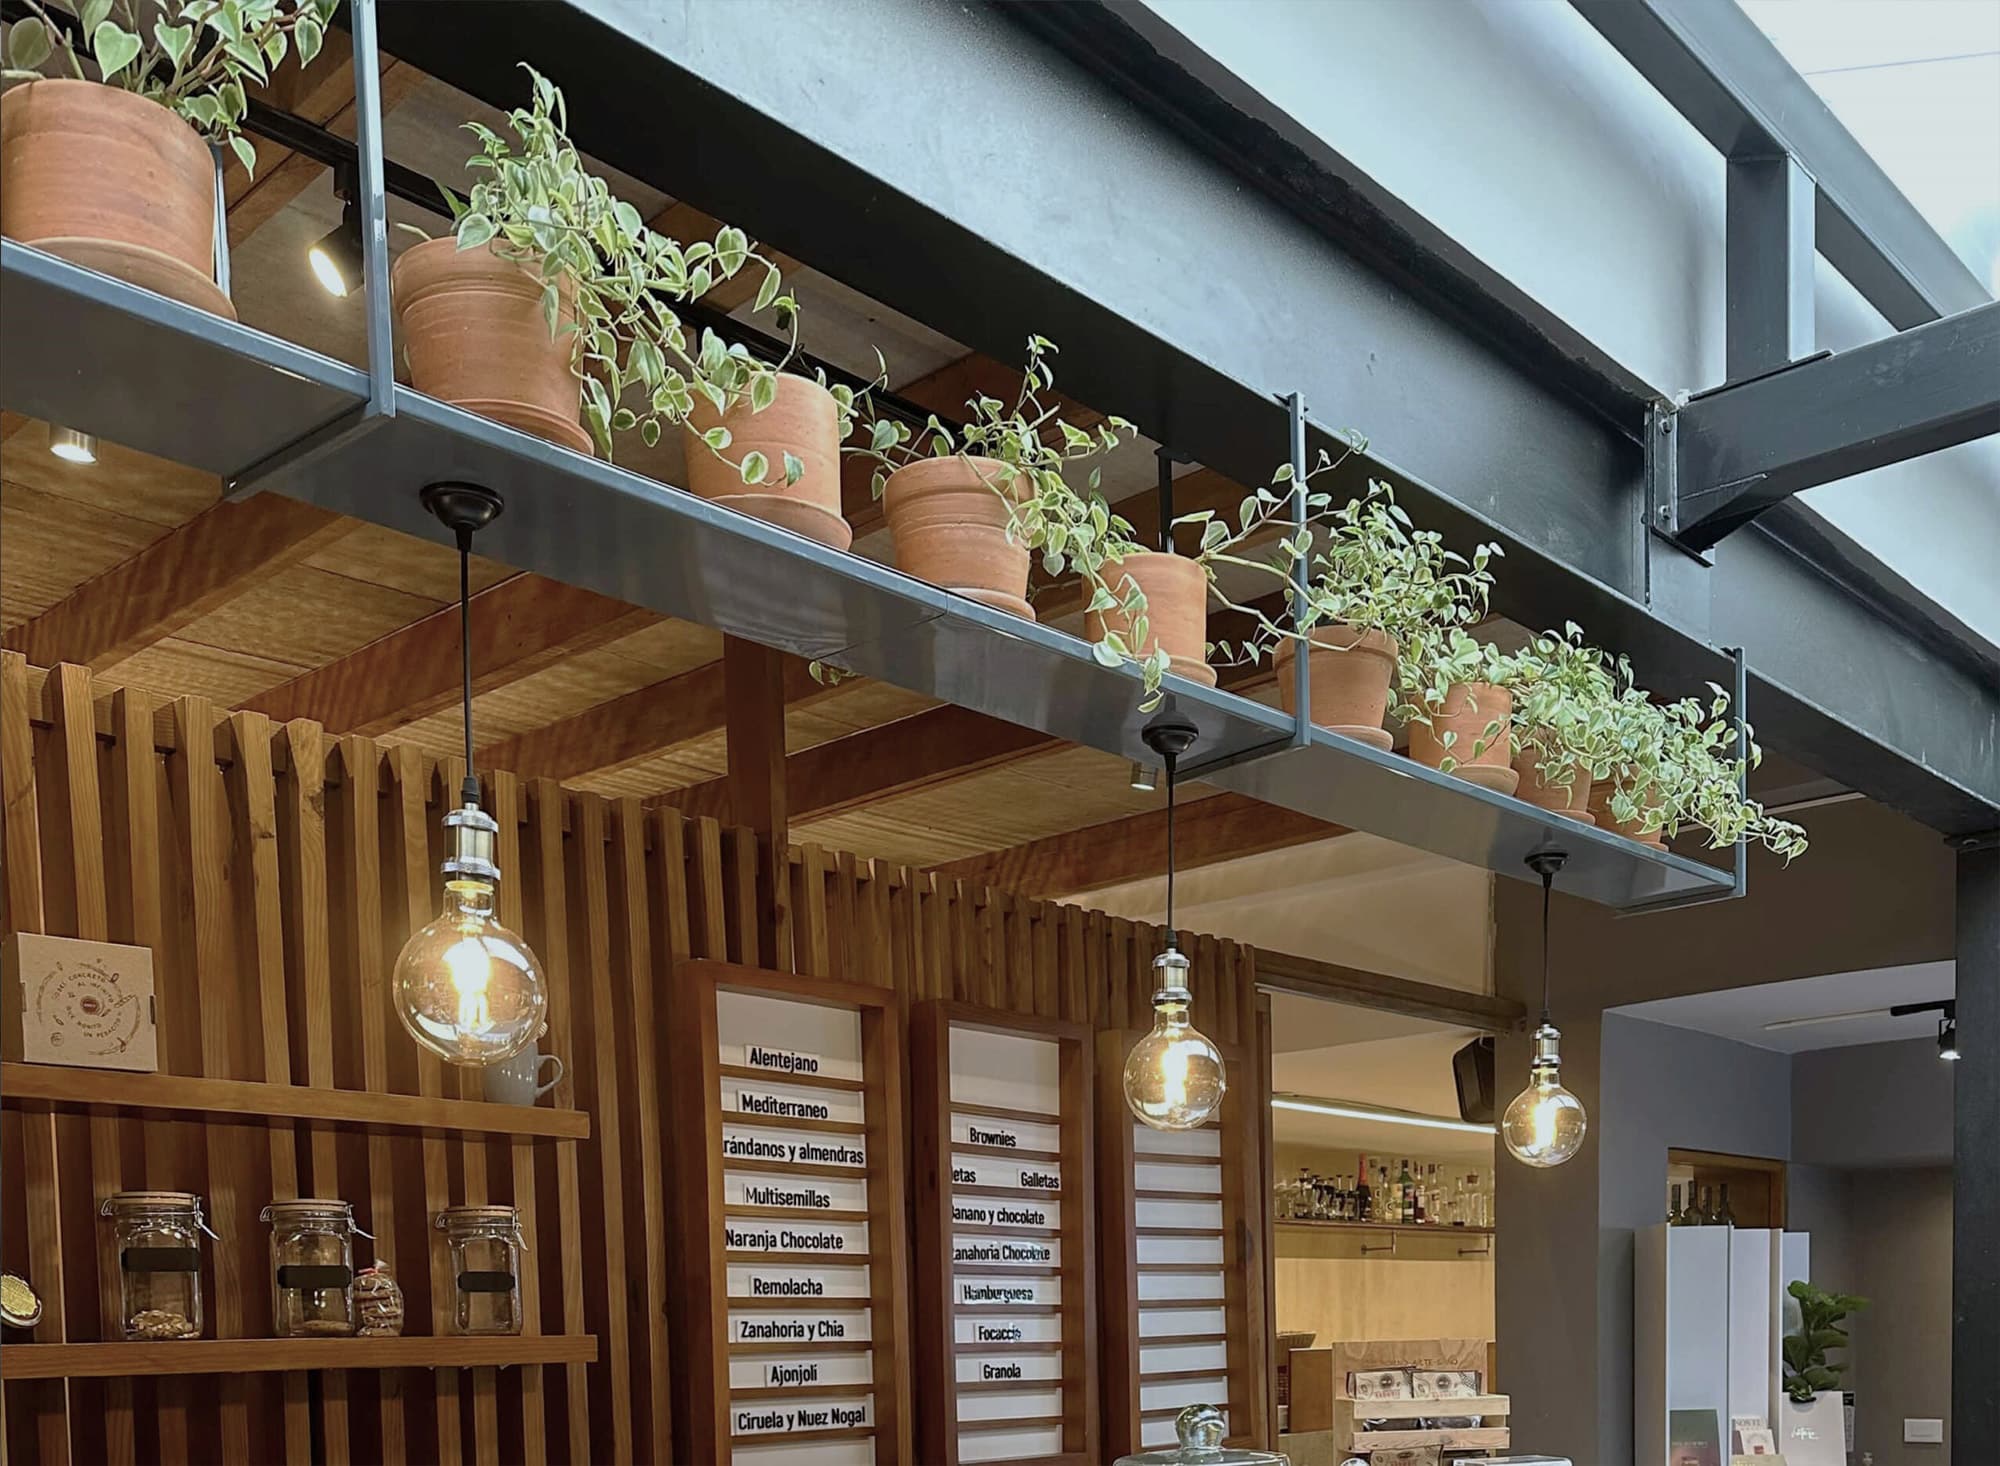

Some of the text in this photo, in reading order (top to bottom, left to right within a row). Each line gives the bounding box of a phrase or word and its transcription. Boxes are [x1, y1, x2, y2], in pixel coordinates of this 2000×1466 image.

[750, 1047, 818, 1074] Alentejano
[741, 1094, 828, 1119] Mediterraneo
[969, 1127, 1016, 1147] Brownies
[788, 1145, 797, 1162] y
[799, 1143, 864, 1164] almendras
[953, 1168, 1060, 1189] etas Galletas
[745, 1187, 830, 1208] Multisemillas
[988, 1210, 995, 1225] y
[997, 1207, 1045, 1225] chocolate
[725, 1229, 843, 1251] Naranja Chocolate
[953, 1244, 1000, 1260] anahoria
[753, 1277, 823, 1296] Remolacha
[740, 1320, 844, 1341] Zanahoria y Chia
[983, 1363, 1022, 1380] Granola
[738, 1406, 866, 1431] Ciruela y Nuez Nogal
